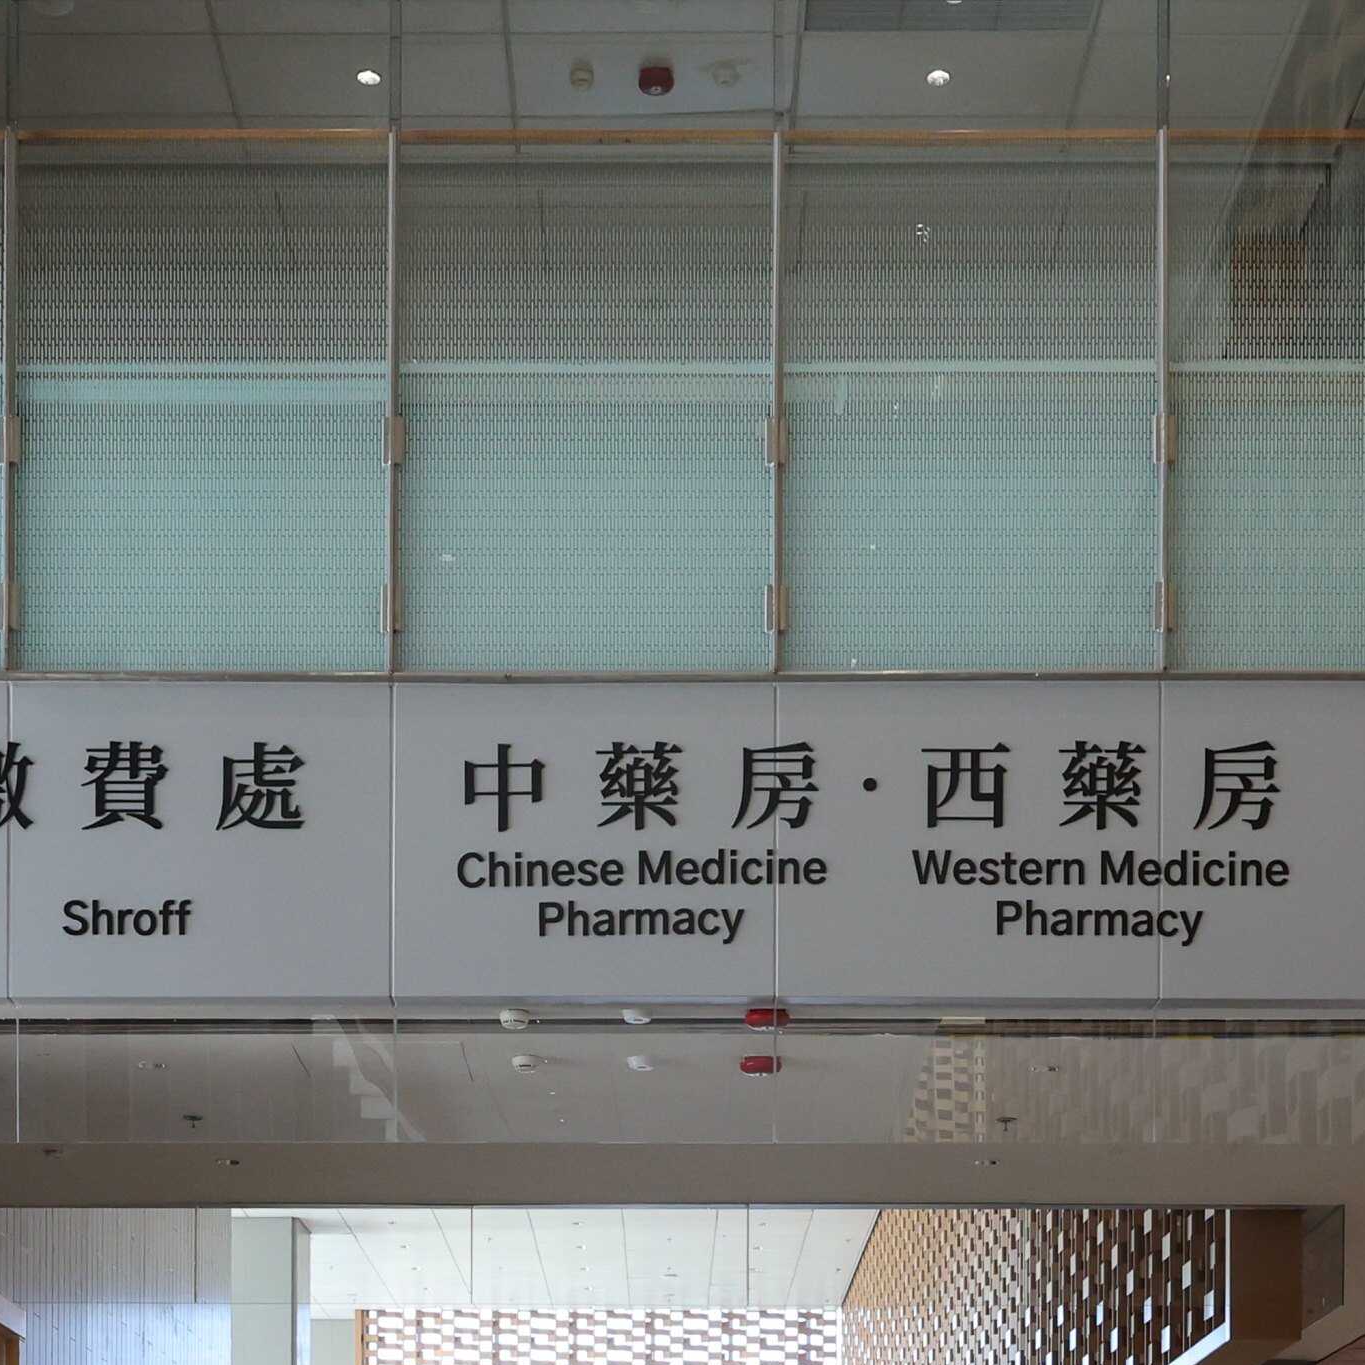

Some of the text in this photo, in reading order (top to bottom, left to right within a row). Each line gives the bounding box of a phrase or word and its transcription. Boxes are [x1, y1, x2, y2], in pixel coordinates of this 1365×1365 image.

[456, 849, 829, 889] Chinese Medicine
[912, 850, 1291, 888] Western Medicine
[62, 899, 194, 937] Shroff
[538, 900, 746, 945] Pharmacy
[996, 900, 1205, 947] Pharmacy
